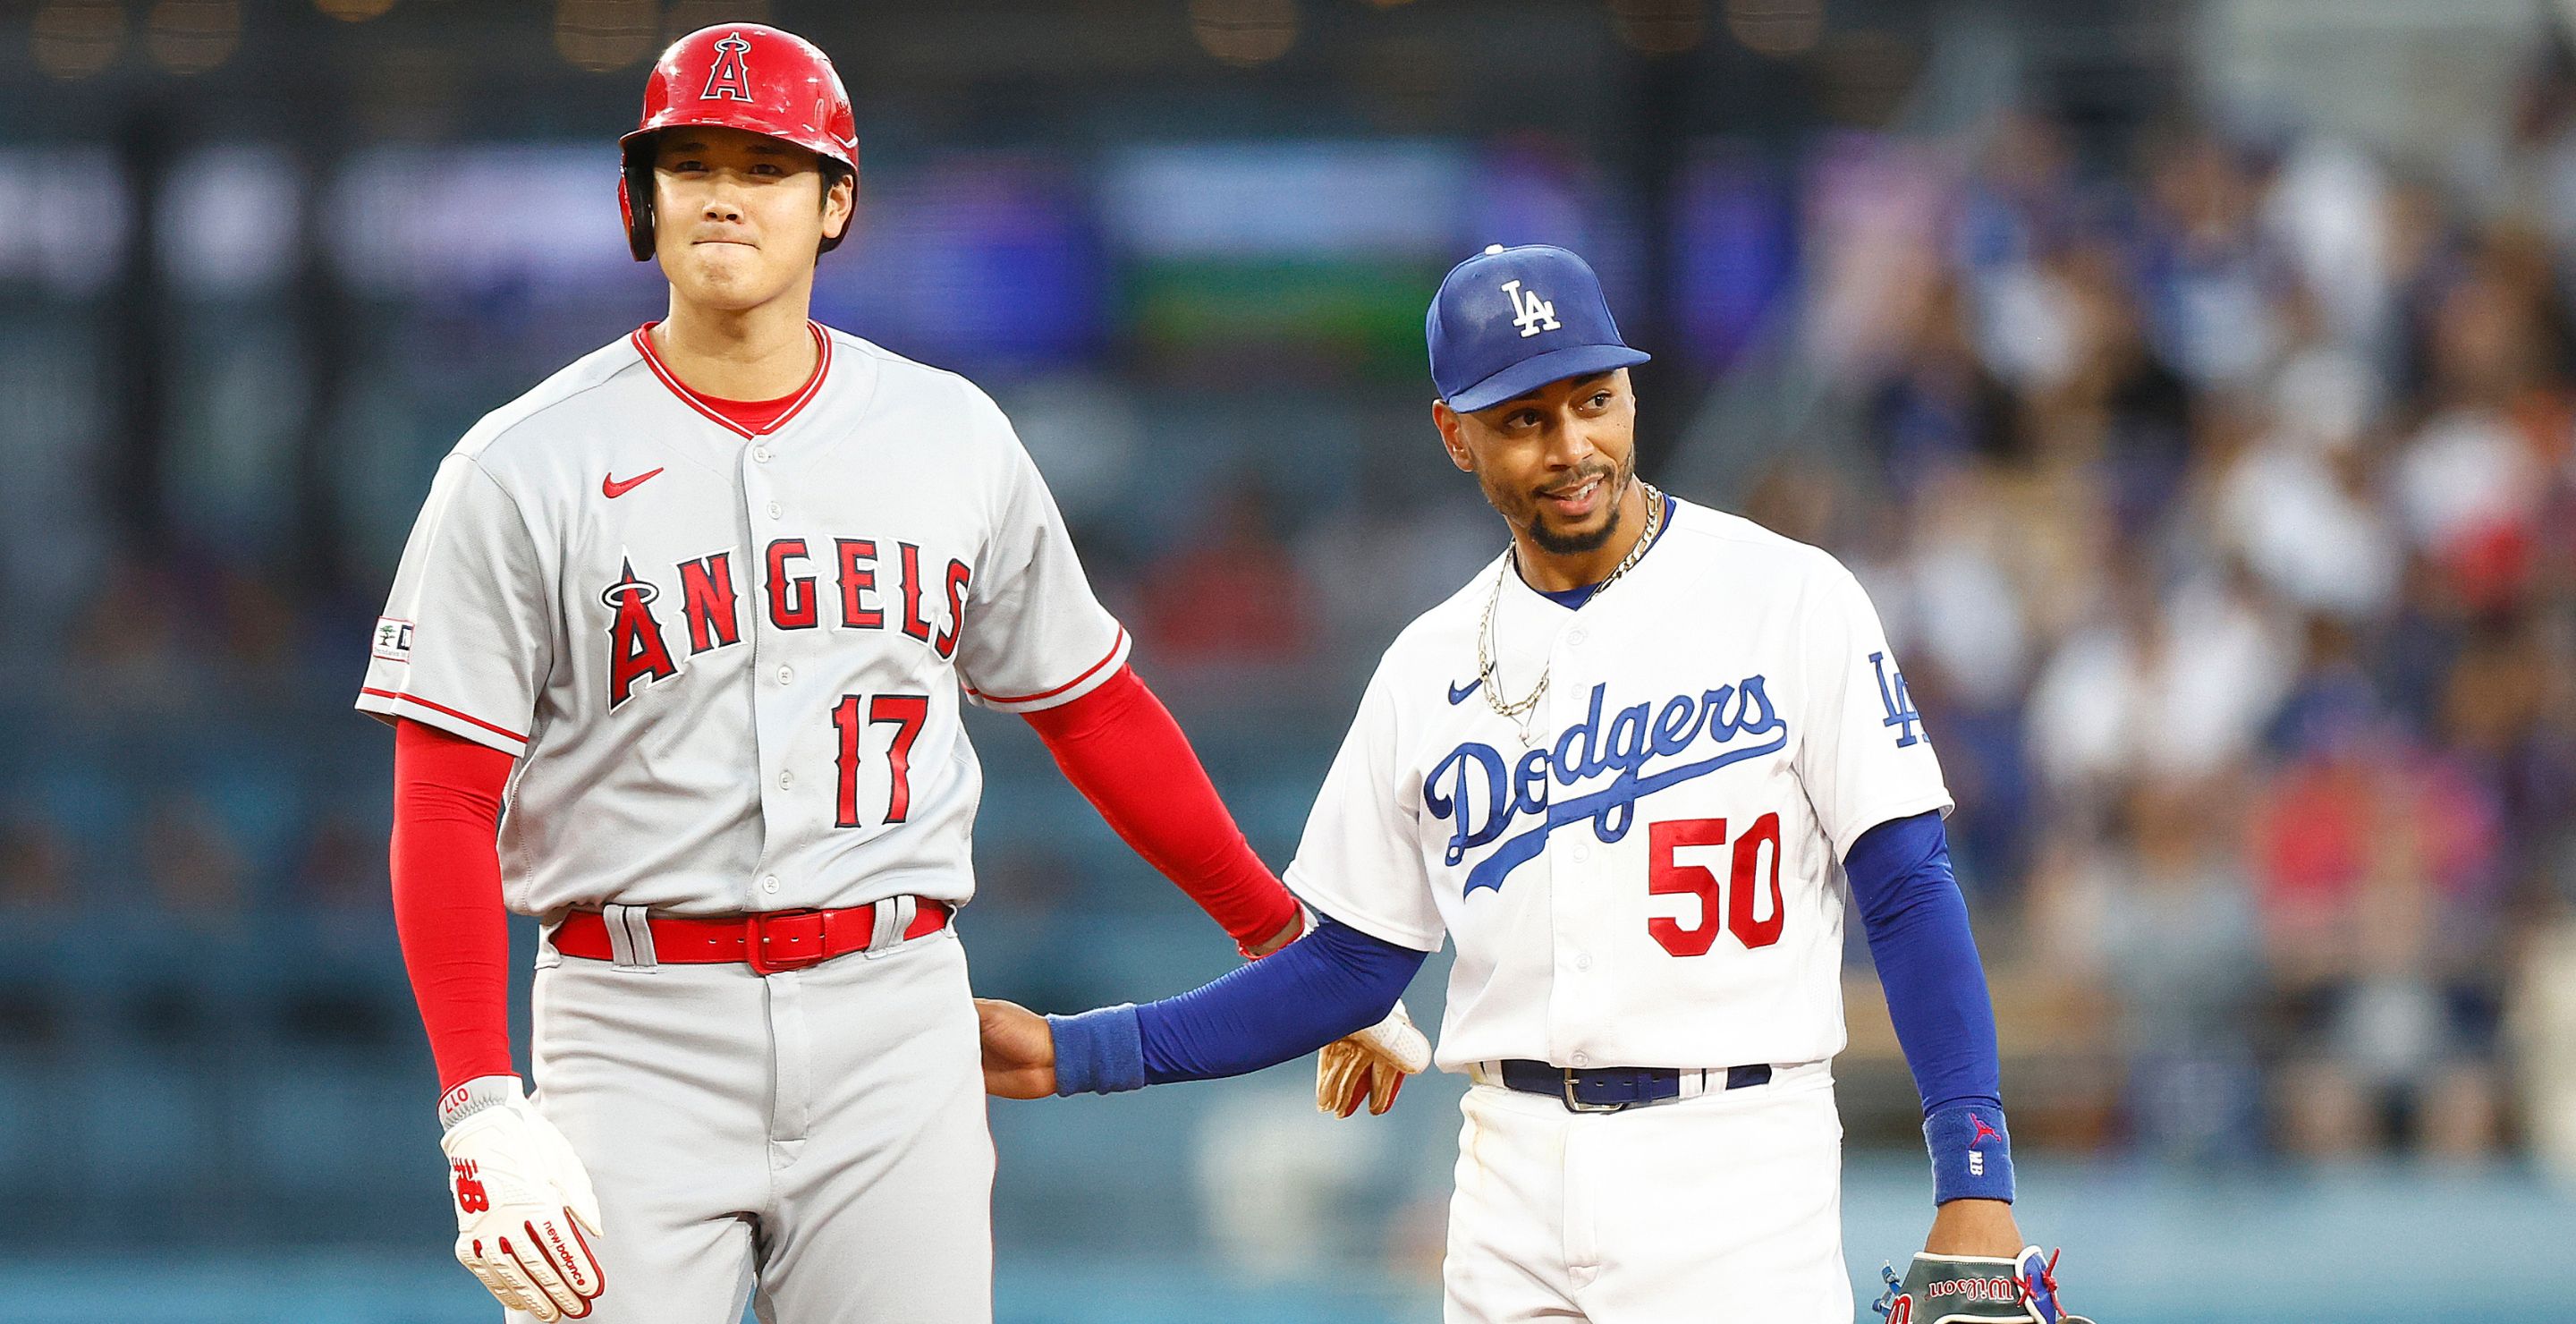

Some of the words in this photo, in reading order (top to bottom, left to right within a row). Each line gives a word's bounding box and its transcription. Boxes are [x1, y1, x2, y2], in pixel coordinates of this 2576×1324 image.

[699, 31, 754, 102] A
[1501, 279, 1562, 338] LA
[599, 536, 971, 714] ANGELS
[831, 694, 929, 828] 17
[1424, 675, 1786, 868] Dodgers
[1648, 811, 1784, 957] 50
[543, 1220, 560, 1244] new
[556, 1243, 585, 1286] balance
[1928, 1277, 2014, 1301] Wilson
